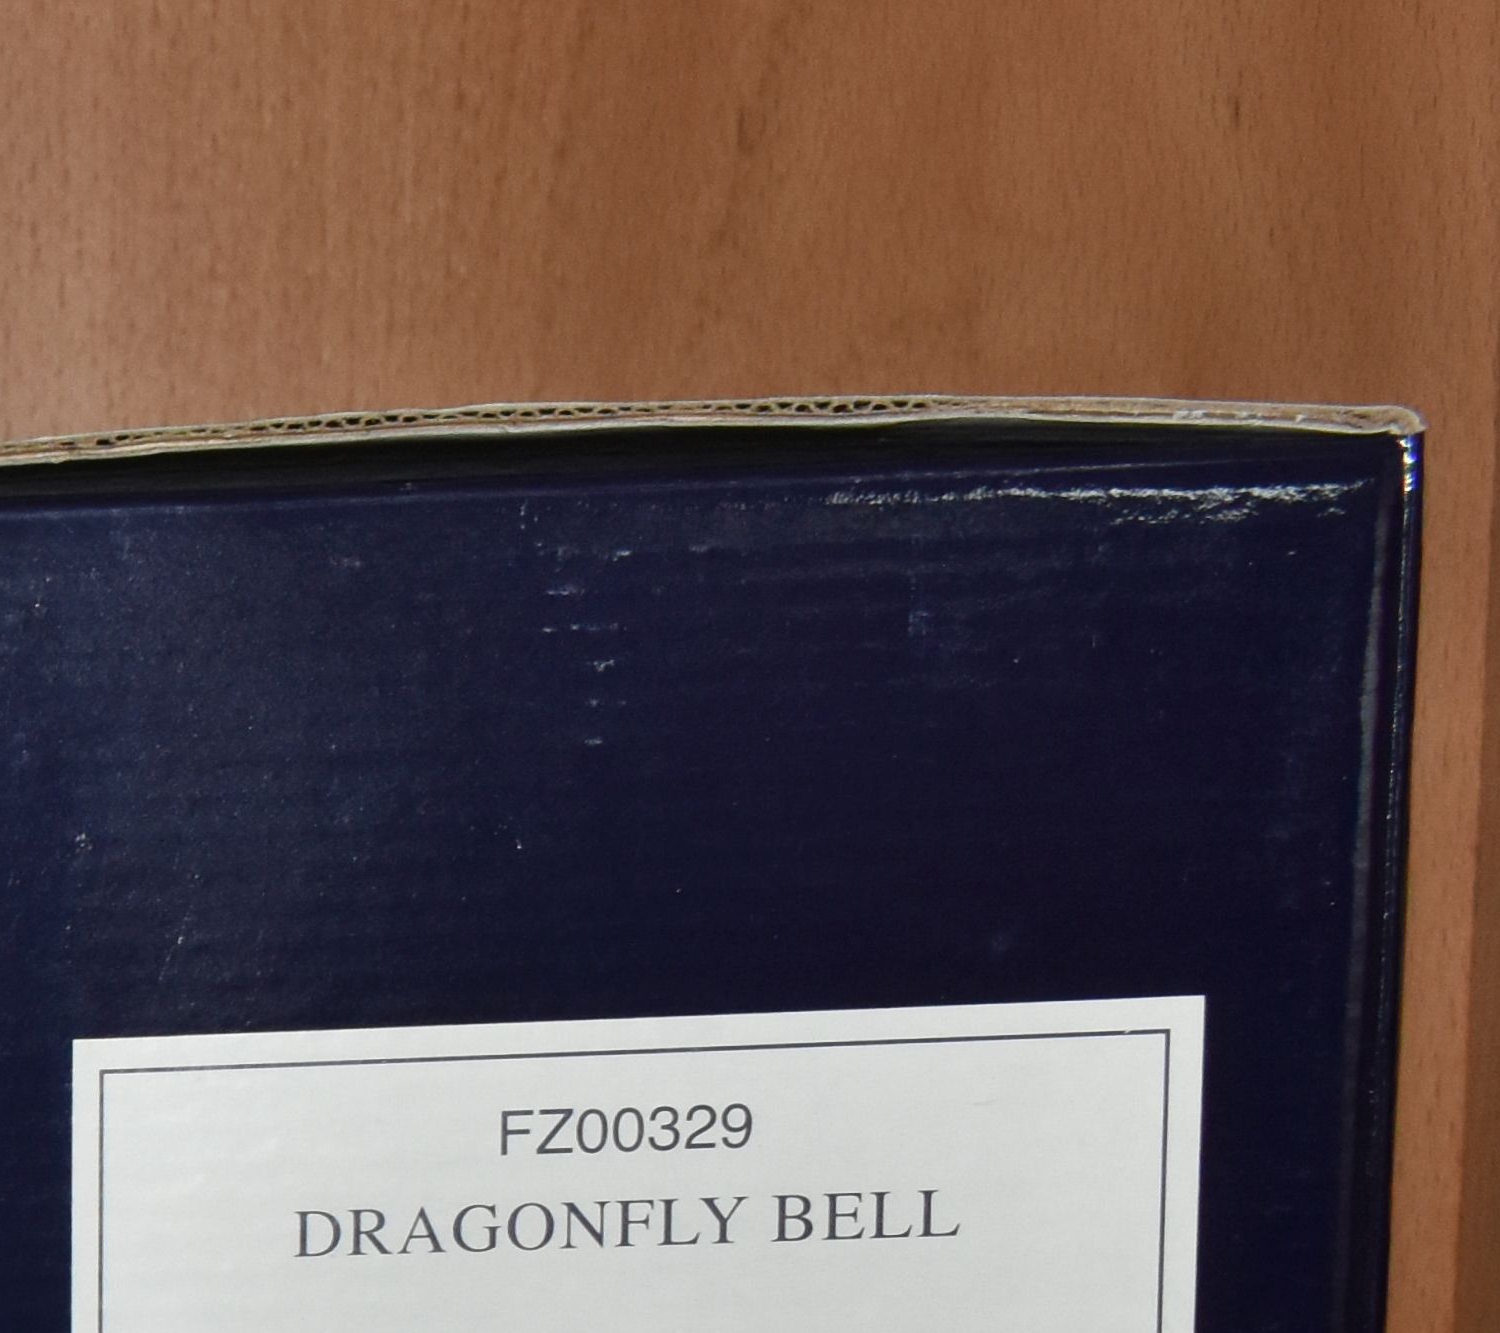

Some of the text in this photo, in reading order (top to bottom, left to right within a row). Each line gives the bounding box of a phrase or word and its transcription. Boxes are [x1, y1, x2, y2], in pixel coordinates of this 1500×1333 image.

[499, 1102, 753, 1156] FZ00329
[293, 1189, 961, 1258] DRAGONFLY BELL
